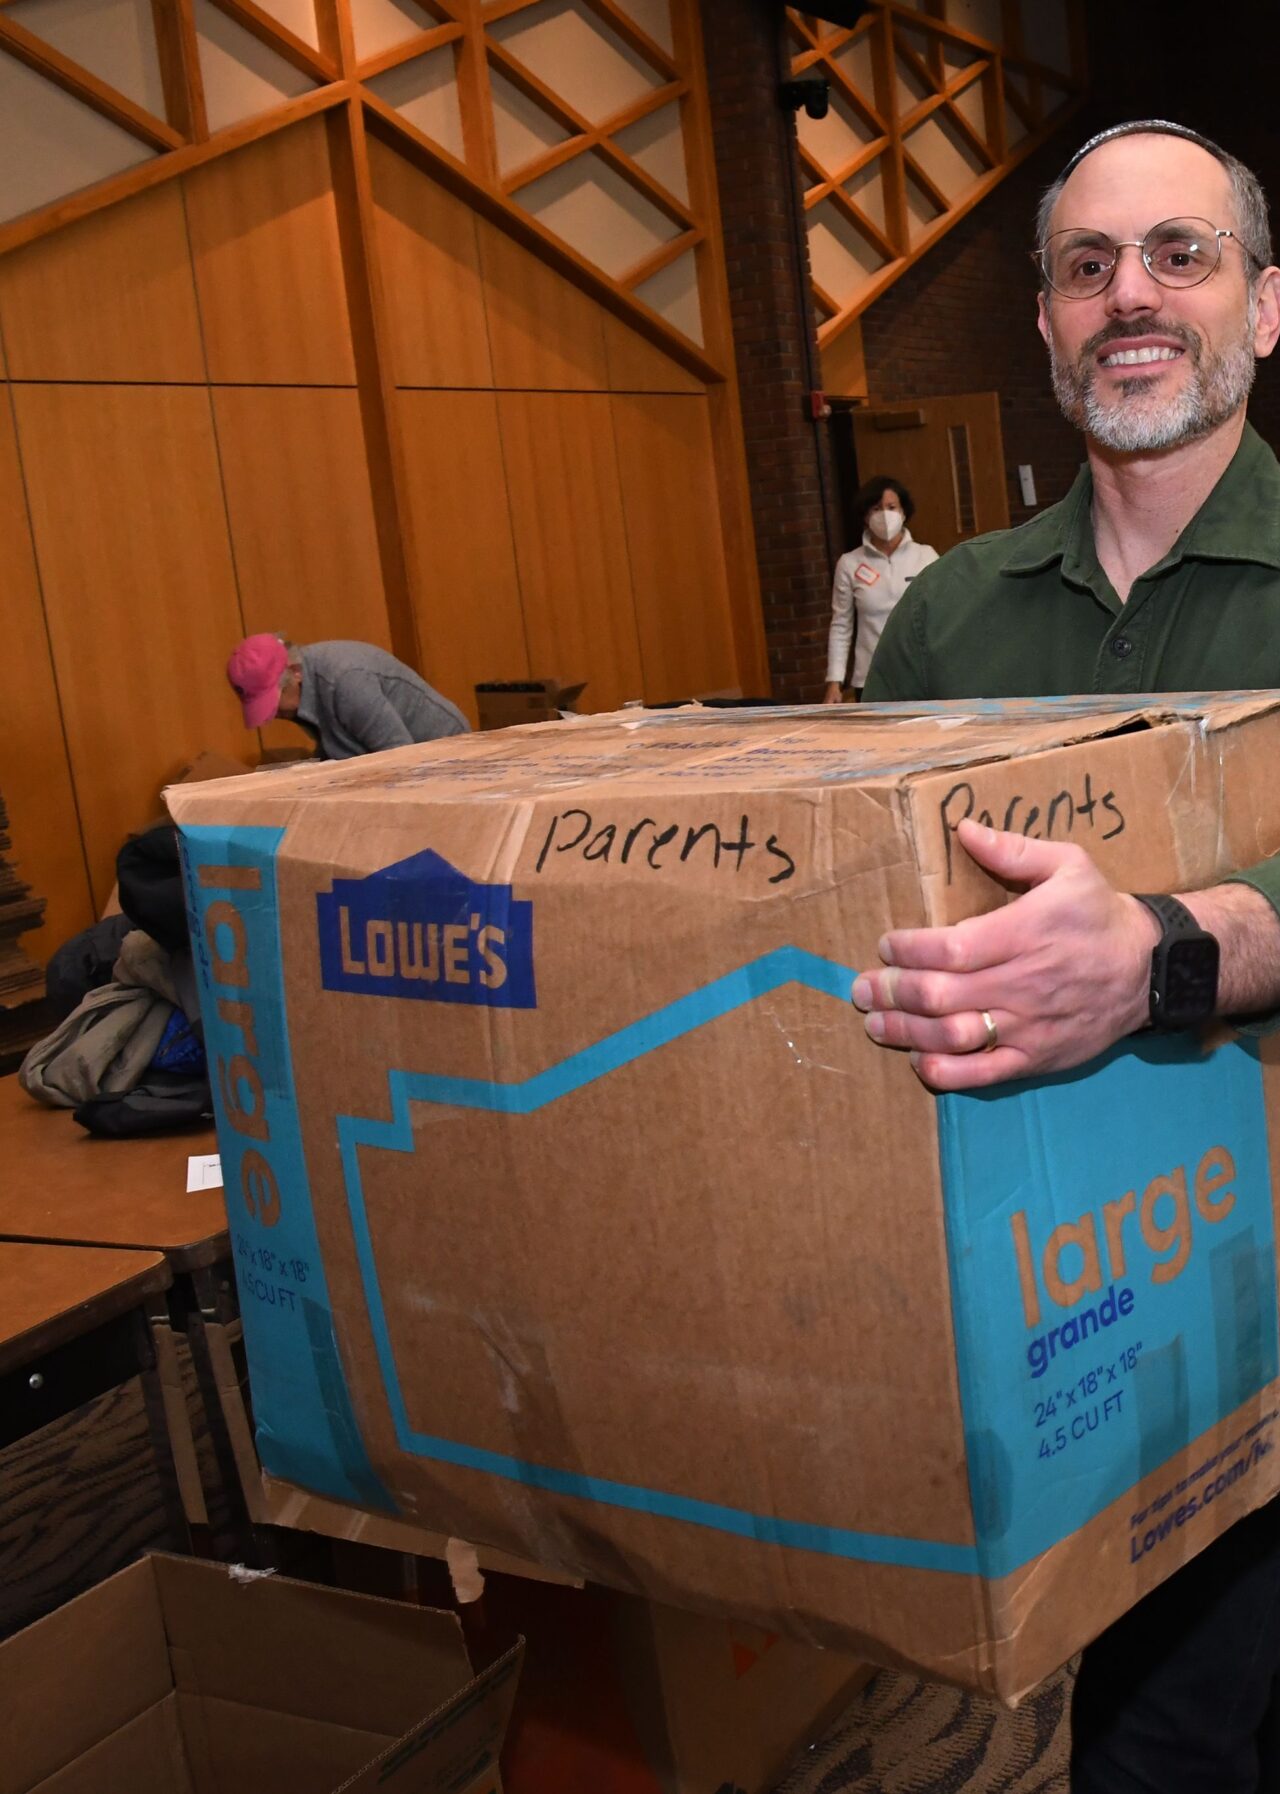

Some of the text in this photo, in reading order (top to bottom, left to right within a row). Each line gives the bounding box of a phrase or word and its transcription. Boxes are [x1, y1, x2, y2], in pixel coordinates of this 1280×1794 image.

[197, 864, 282, 1228] large
[1009, 1145, 1236, 1328] large
[1027, 1285, 1135, 1379] grande
[1034, 1390, 1063, 1427] 24"
[1078, 1366, 1104, 1396] 18"
[1106, 1364, 1118, 1382] x
[1119, 1341, 1143, 1370] 18"
[1038, 1390, 1124, 1460] 4.5 CU FT
